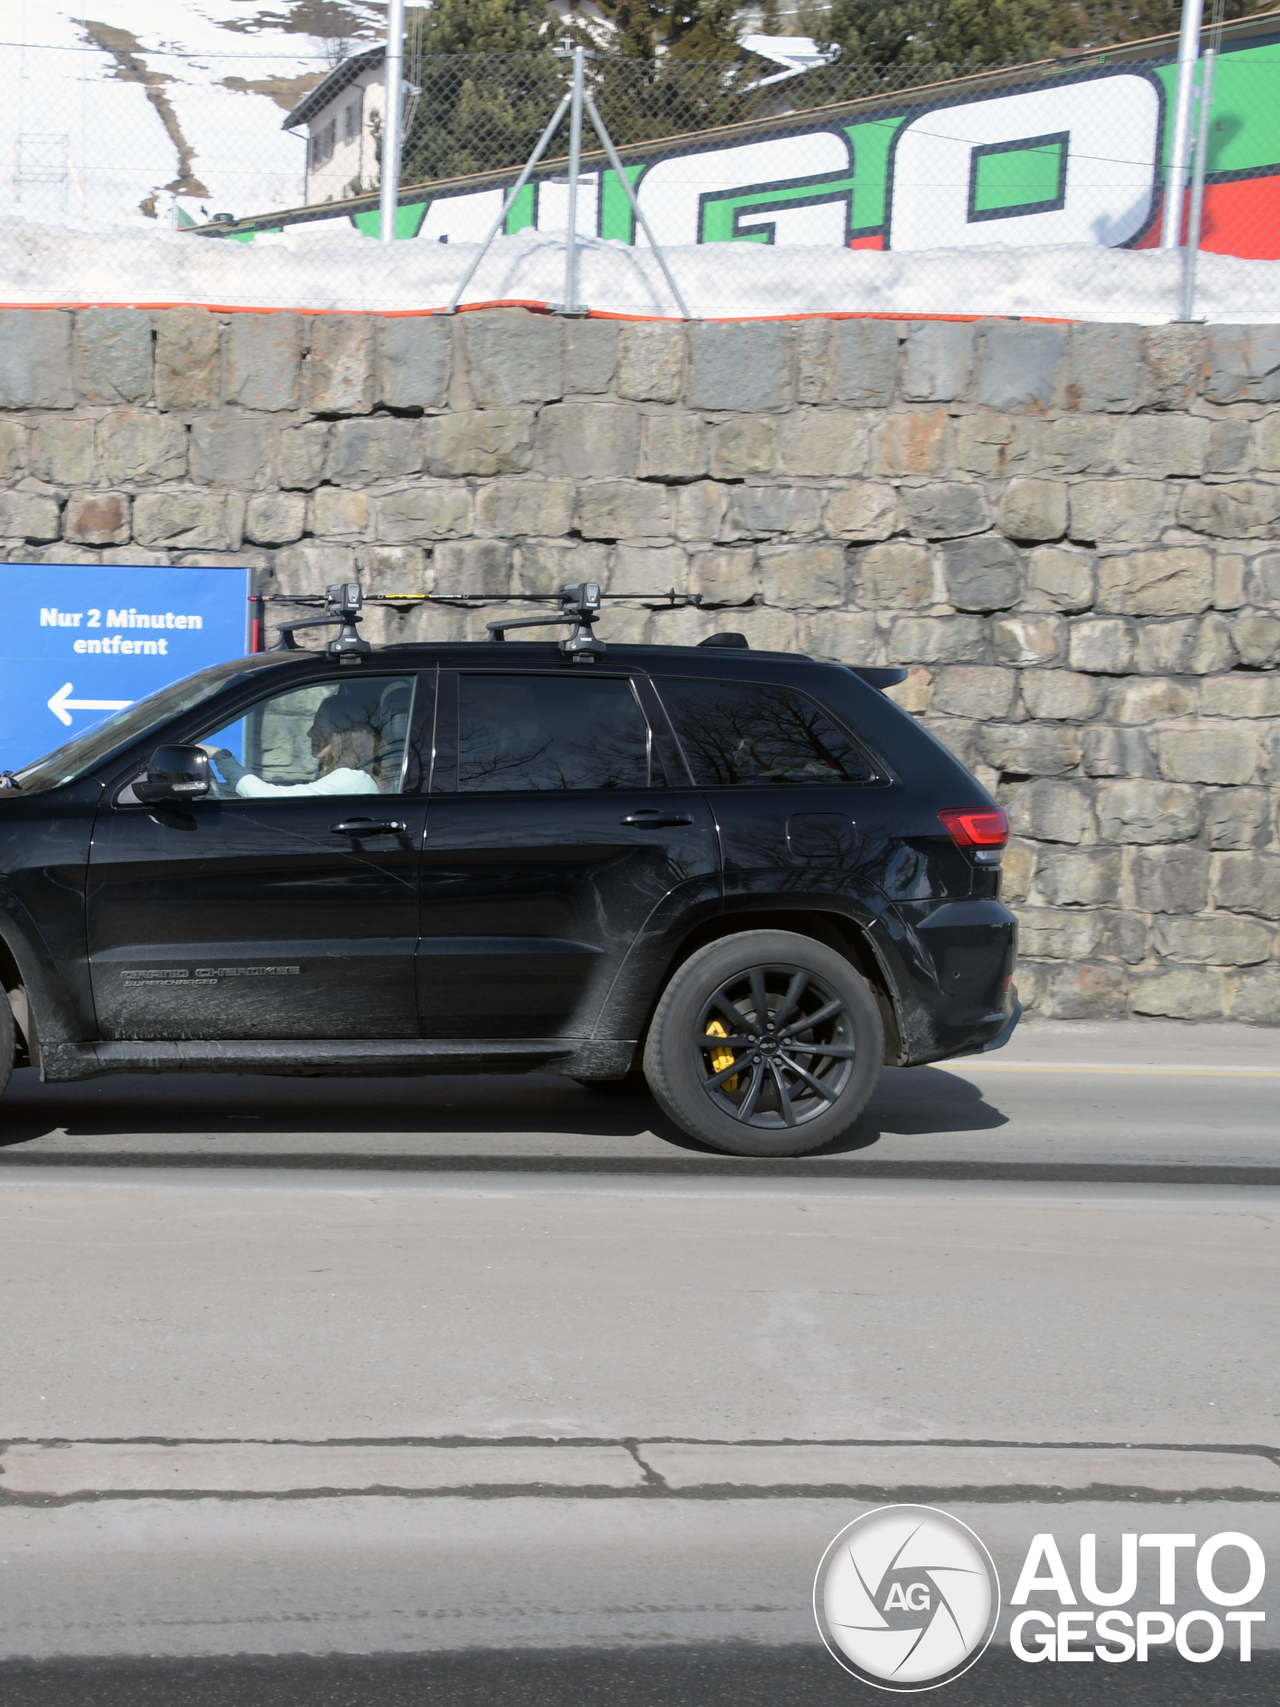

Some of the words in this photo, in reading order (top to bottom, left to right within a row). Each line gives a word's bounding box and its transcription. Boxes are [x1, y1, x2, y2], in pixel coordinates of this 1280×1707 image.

[40, 608, 83, 626] Nur
[86, 609, 101, 627] 2
[106, 609, 203, 629] Minuten
[73, 635, 168, 655] entfernt
[121, 968, 189, 979] GRAND
[195, 966, 300, 977] CHEROKEE
[123, 978, 218, 987] SUPERCHARGED
